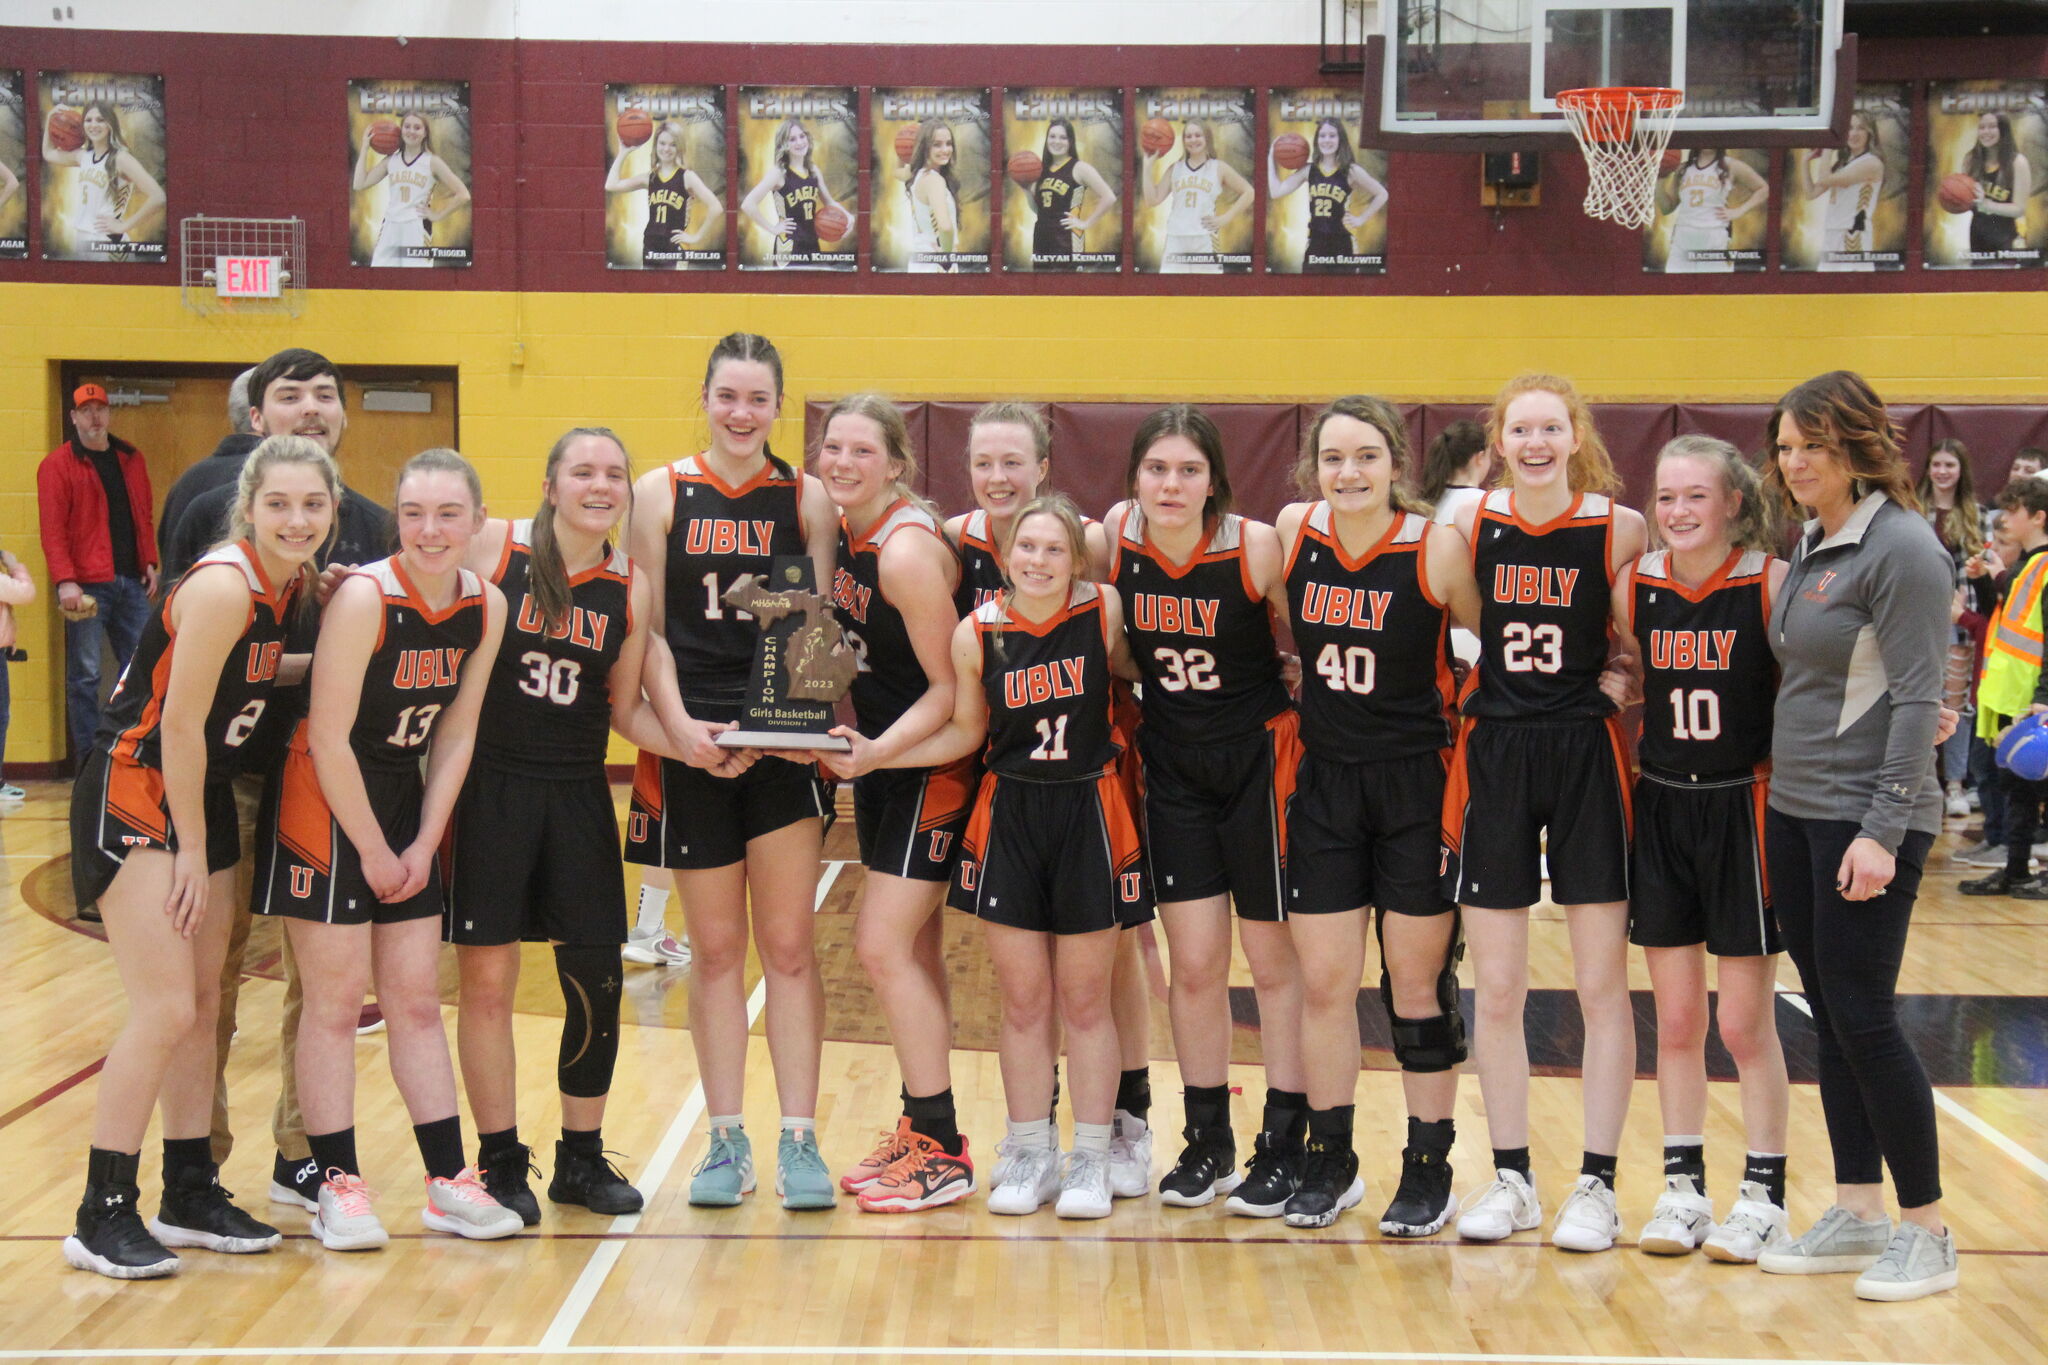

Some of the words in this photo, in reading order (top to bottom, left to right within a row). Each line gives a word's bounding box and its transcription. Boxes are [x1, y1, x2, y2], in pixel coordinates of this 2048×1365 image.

[1310, 183, 1347, 203] AGLES
[226, 258, 271, 293] EXIT
[685, 518, 775, 557] UBLY
[1301, 581, 1393, 631] UBLY
[1494, 564, 1580, 607] UBLY
[1134, 592, 1220, 637] UBLY
[393, 648, 468, 689] UBLY
[1316, 643, 1376, 695] 40
[1503, 622, 1563, 674] 23
[1650, 629, 1737, 670] UBLY
[518, 650, 582, 705] 30
[762, 636, 777, 703] CHAMPION
[804, 679, 834, 689] 2023
[1004, 656, 1085, 708] UBLY
[1153, 647, 1222, 692] 32
[386, 704, 442, 747] 13
[749, 707, 773, 718] Girls
[774, 708, 827, 720] Basketball
[767, 719, 800, 727] DIVISION
[1669, 688, 1721, 740] 10
[1029, 714, 1069, 761] 11
[630, 811, 649, 844] U
[929, 829, 953, 863] U
[290, 864, 314, 898] U
[1120, 872, 1140, 903] U
